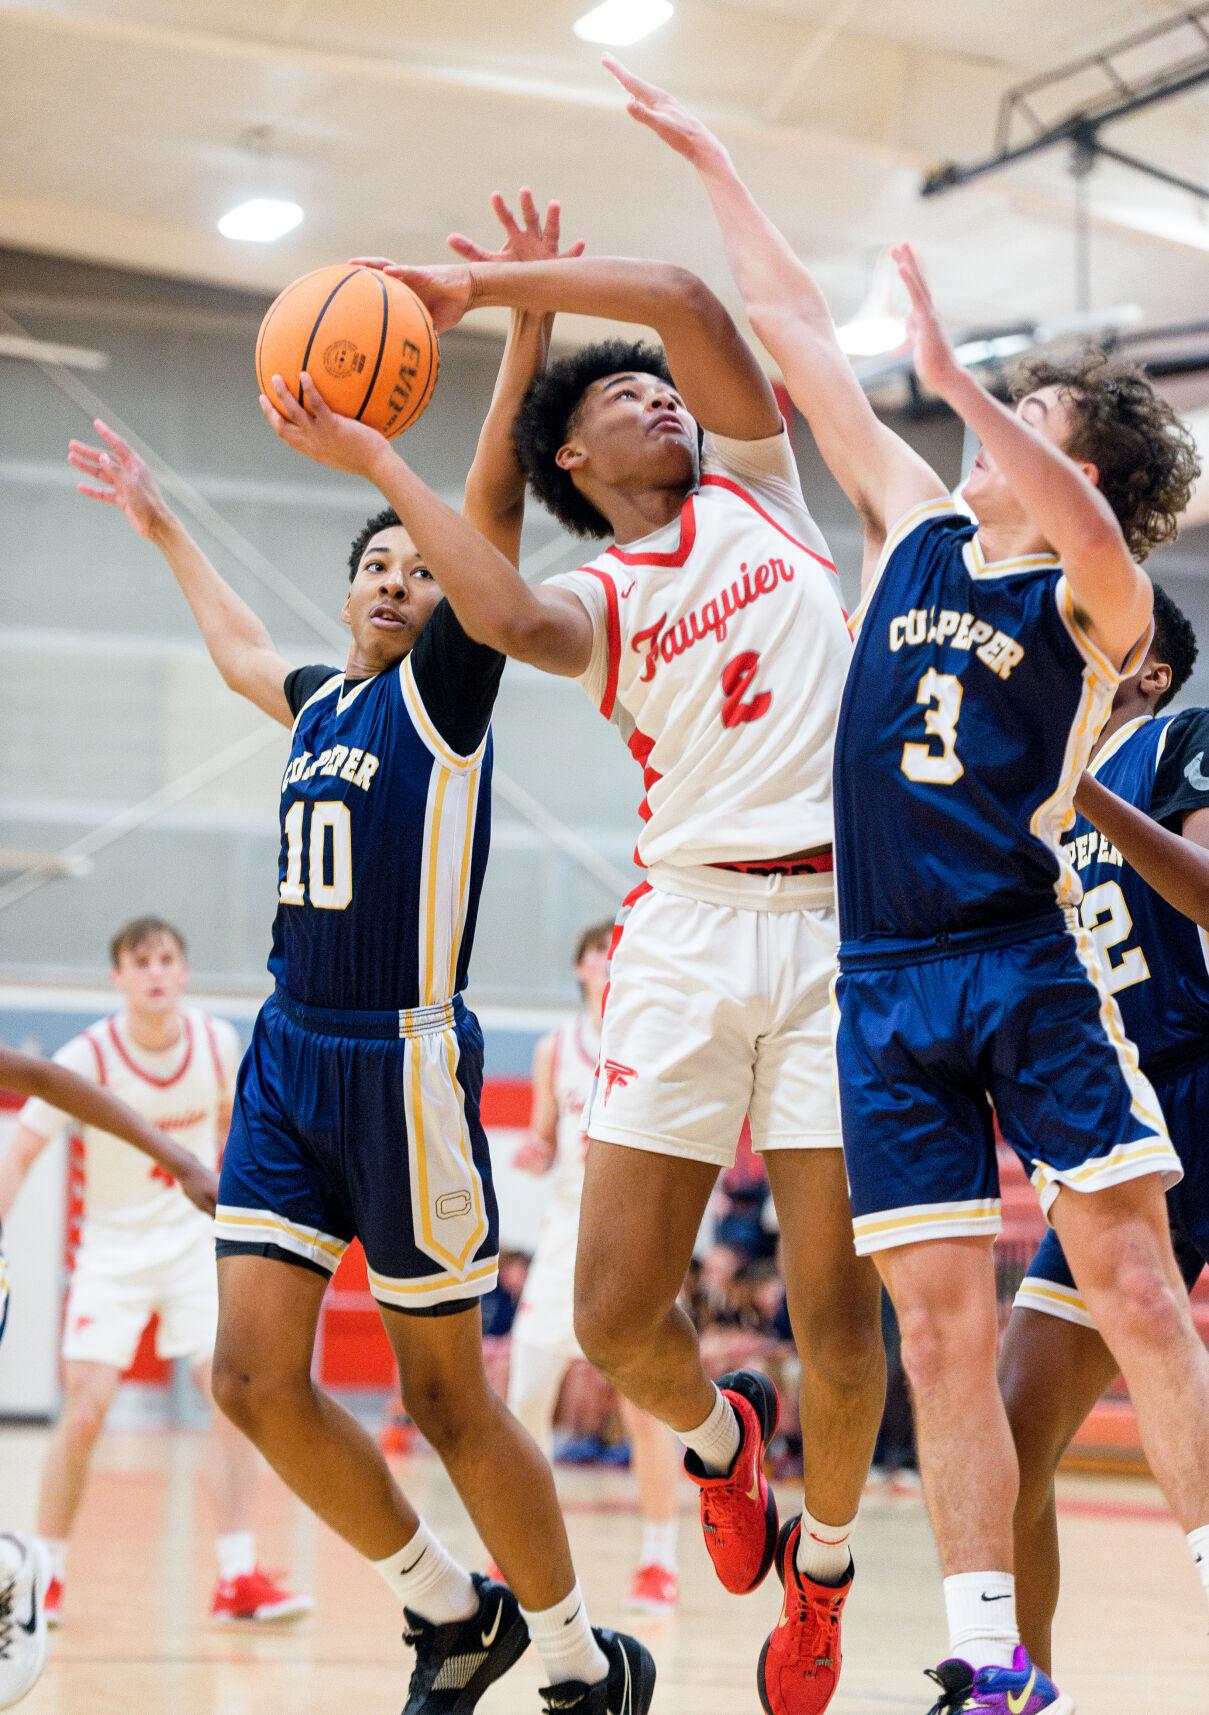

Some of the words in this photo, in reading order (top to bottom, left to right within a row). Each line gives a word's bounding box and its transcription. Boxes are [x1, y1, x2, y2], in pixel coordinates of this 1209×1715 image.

[631, 558, 794, 682] Fauquier
[889, 604, 1025, 680] CULPEPER
[721, 649, 773, 729] 2
[901, 667, 965, 785] 3
[280, 800, 353, 910] 10
[1073, 880, 1151, 996] 2
